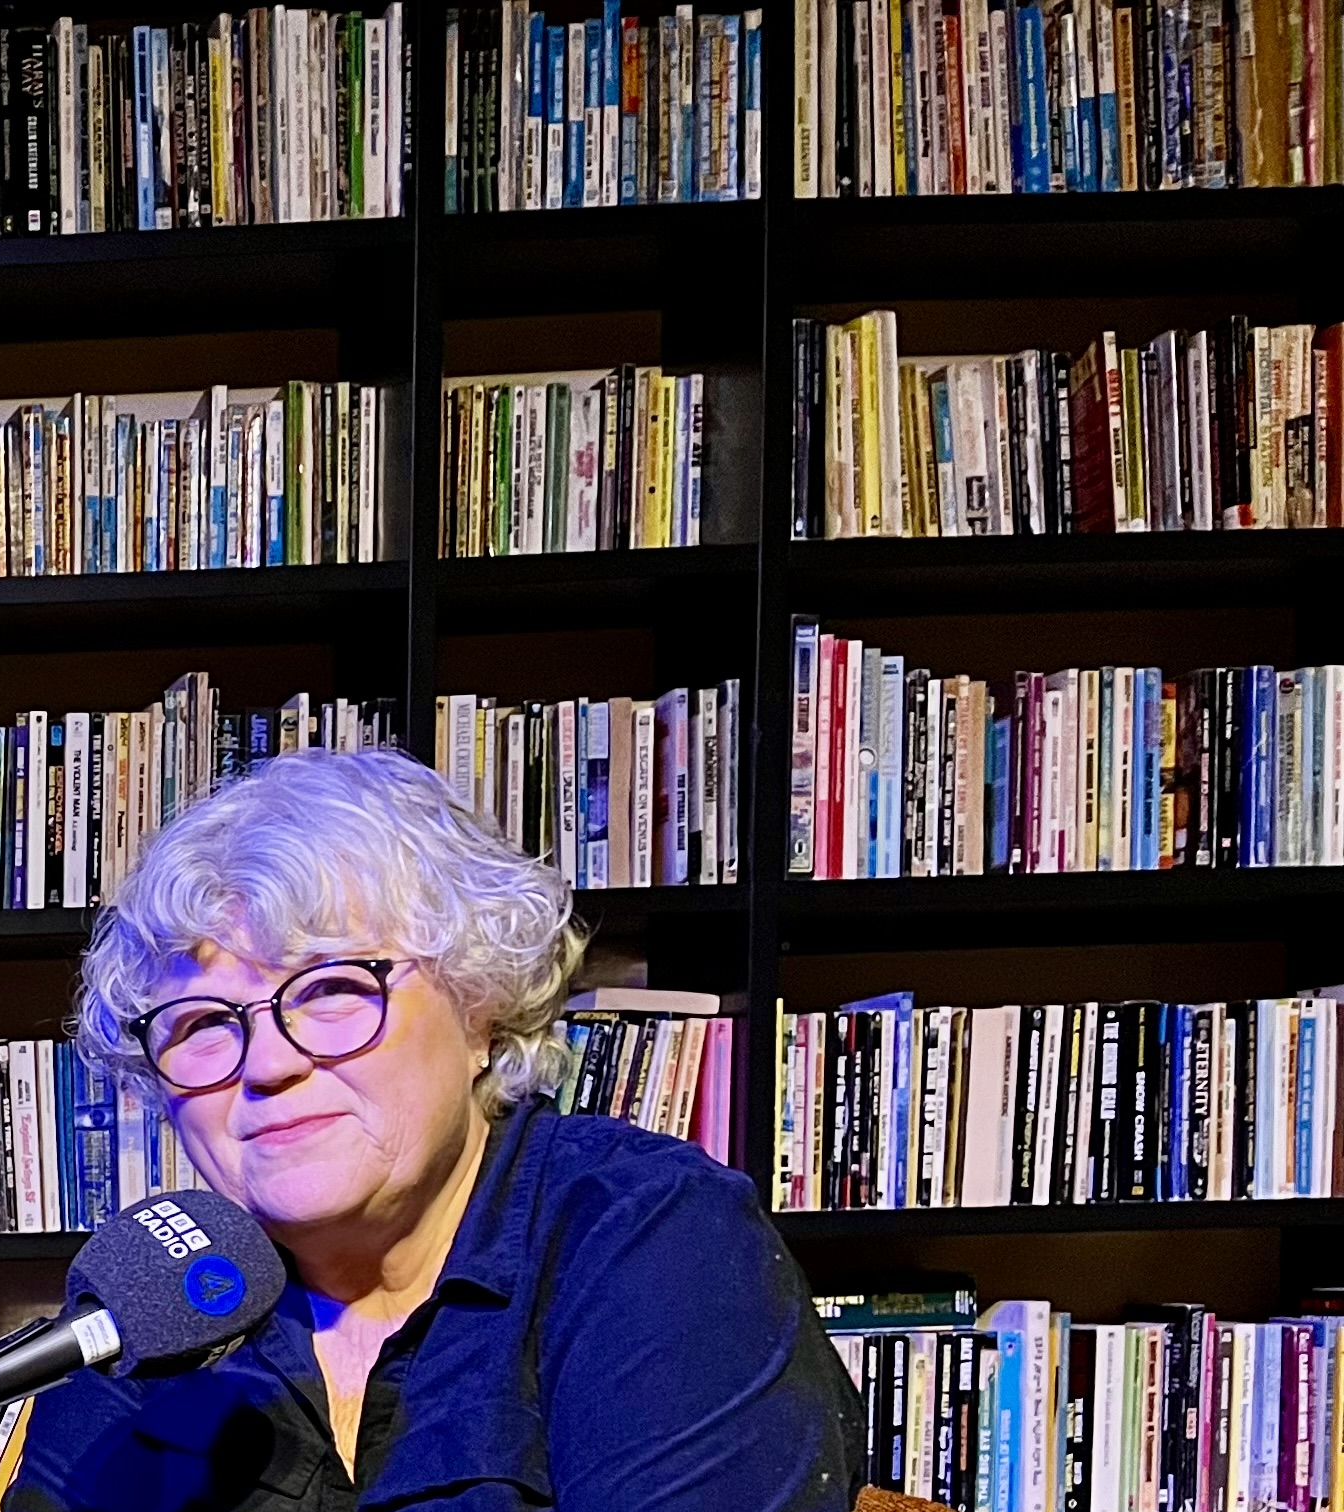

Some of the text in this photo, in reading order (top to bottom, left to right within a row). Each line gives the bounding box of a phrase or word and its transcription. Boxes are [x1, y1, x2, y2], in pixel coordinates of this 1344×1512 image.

[1260, 426, 1272, 487] STATION
[458, 704, 471, 746] MICHAEL
[72, 750, 82, 818] THE VIOLENT MAN
[638, 745, 648, 852] ESCAPE ON VENUS
[1195, 1042, 1208, 1116] ETERNITY
[4, 1126, 12, 1152] TREK
[1135, 1072, 1145, 1161] SNOW CRASH
[133, 1208, 189, 1259] RADIO
[151, 1200, 212, 1252] BBC
